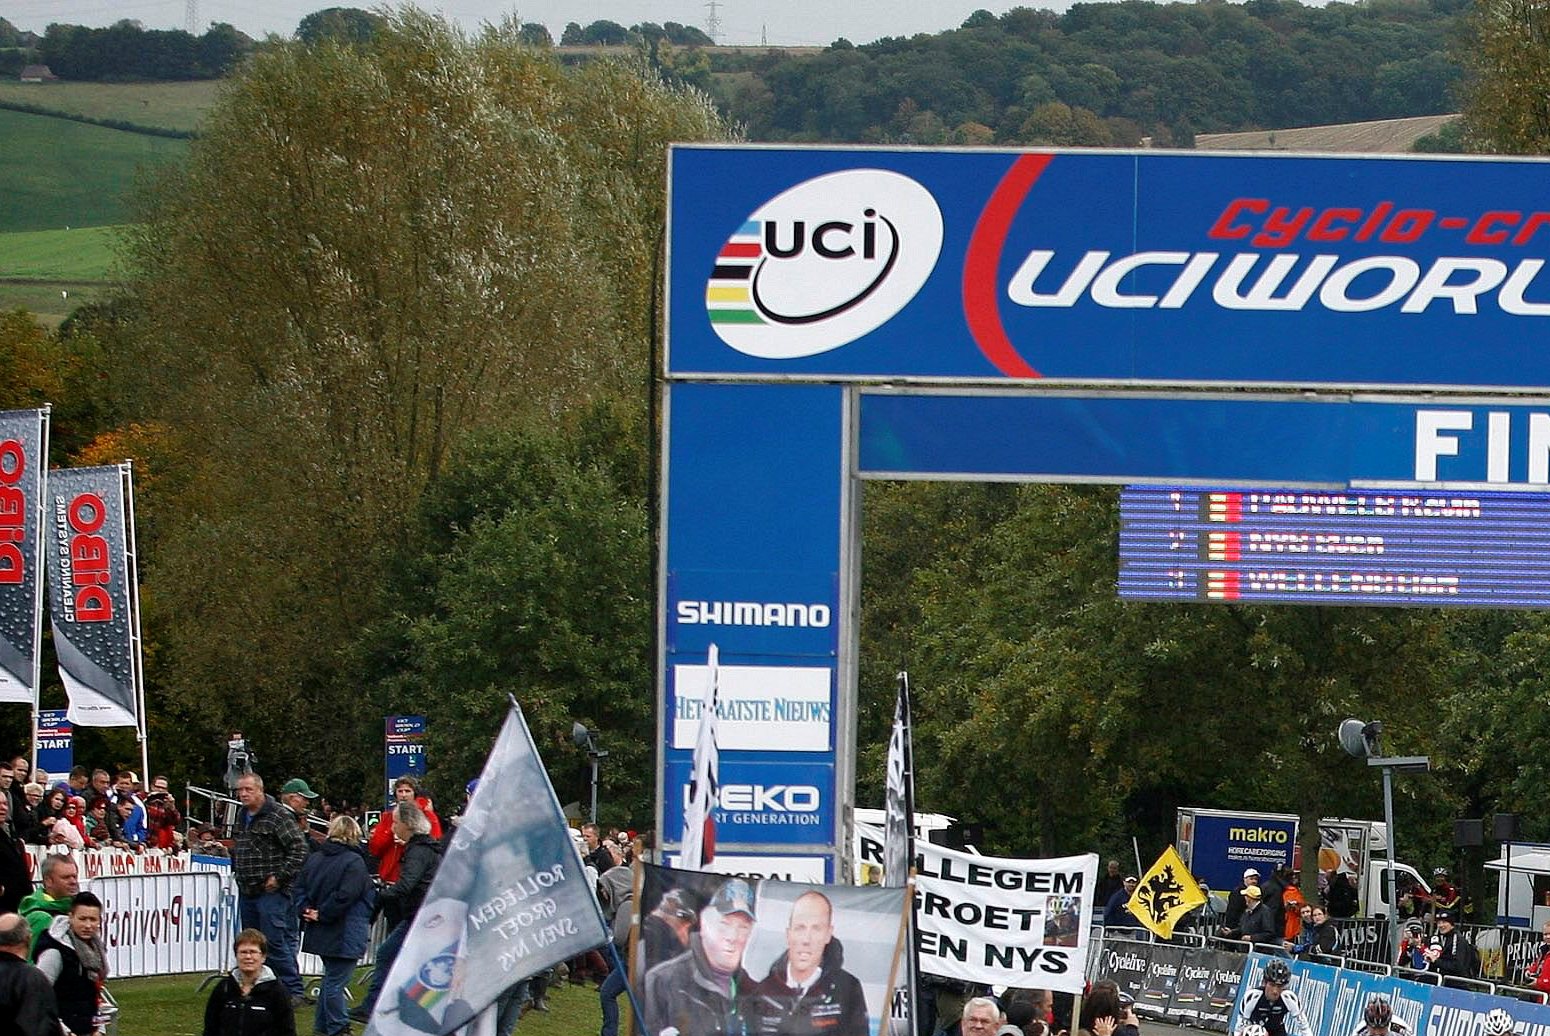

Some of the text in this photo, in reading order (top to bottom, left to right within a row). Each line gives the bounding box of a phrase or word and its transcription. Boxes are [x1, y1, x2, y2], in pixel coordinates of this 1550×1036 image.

[677, 601, 831, 627] SHIMANO
[715, 698, 769, 722] AATSTE
[388, 745, 424, 755] START
[732, 812, 820, 826] GENERATION
[1229, 827, 1288, 844] makro
[984, 943, 1070, 975] NYS
